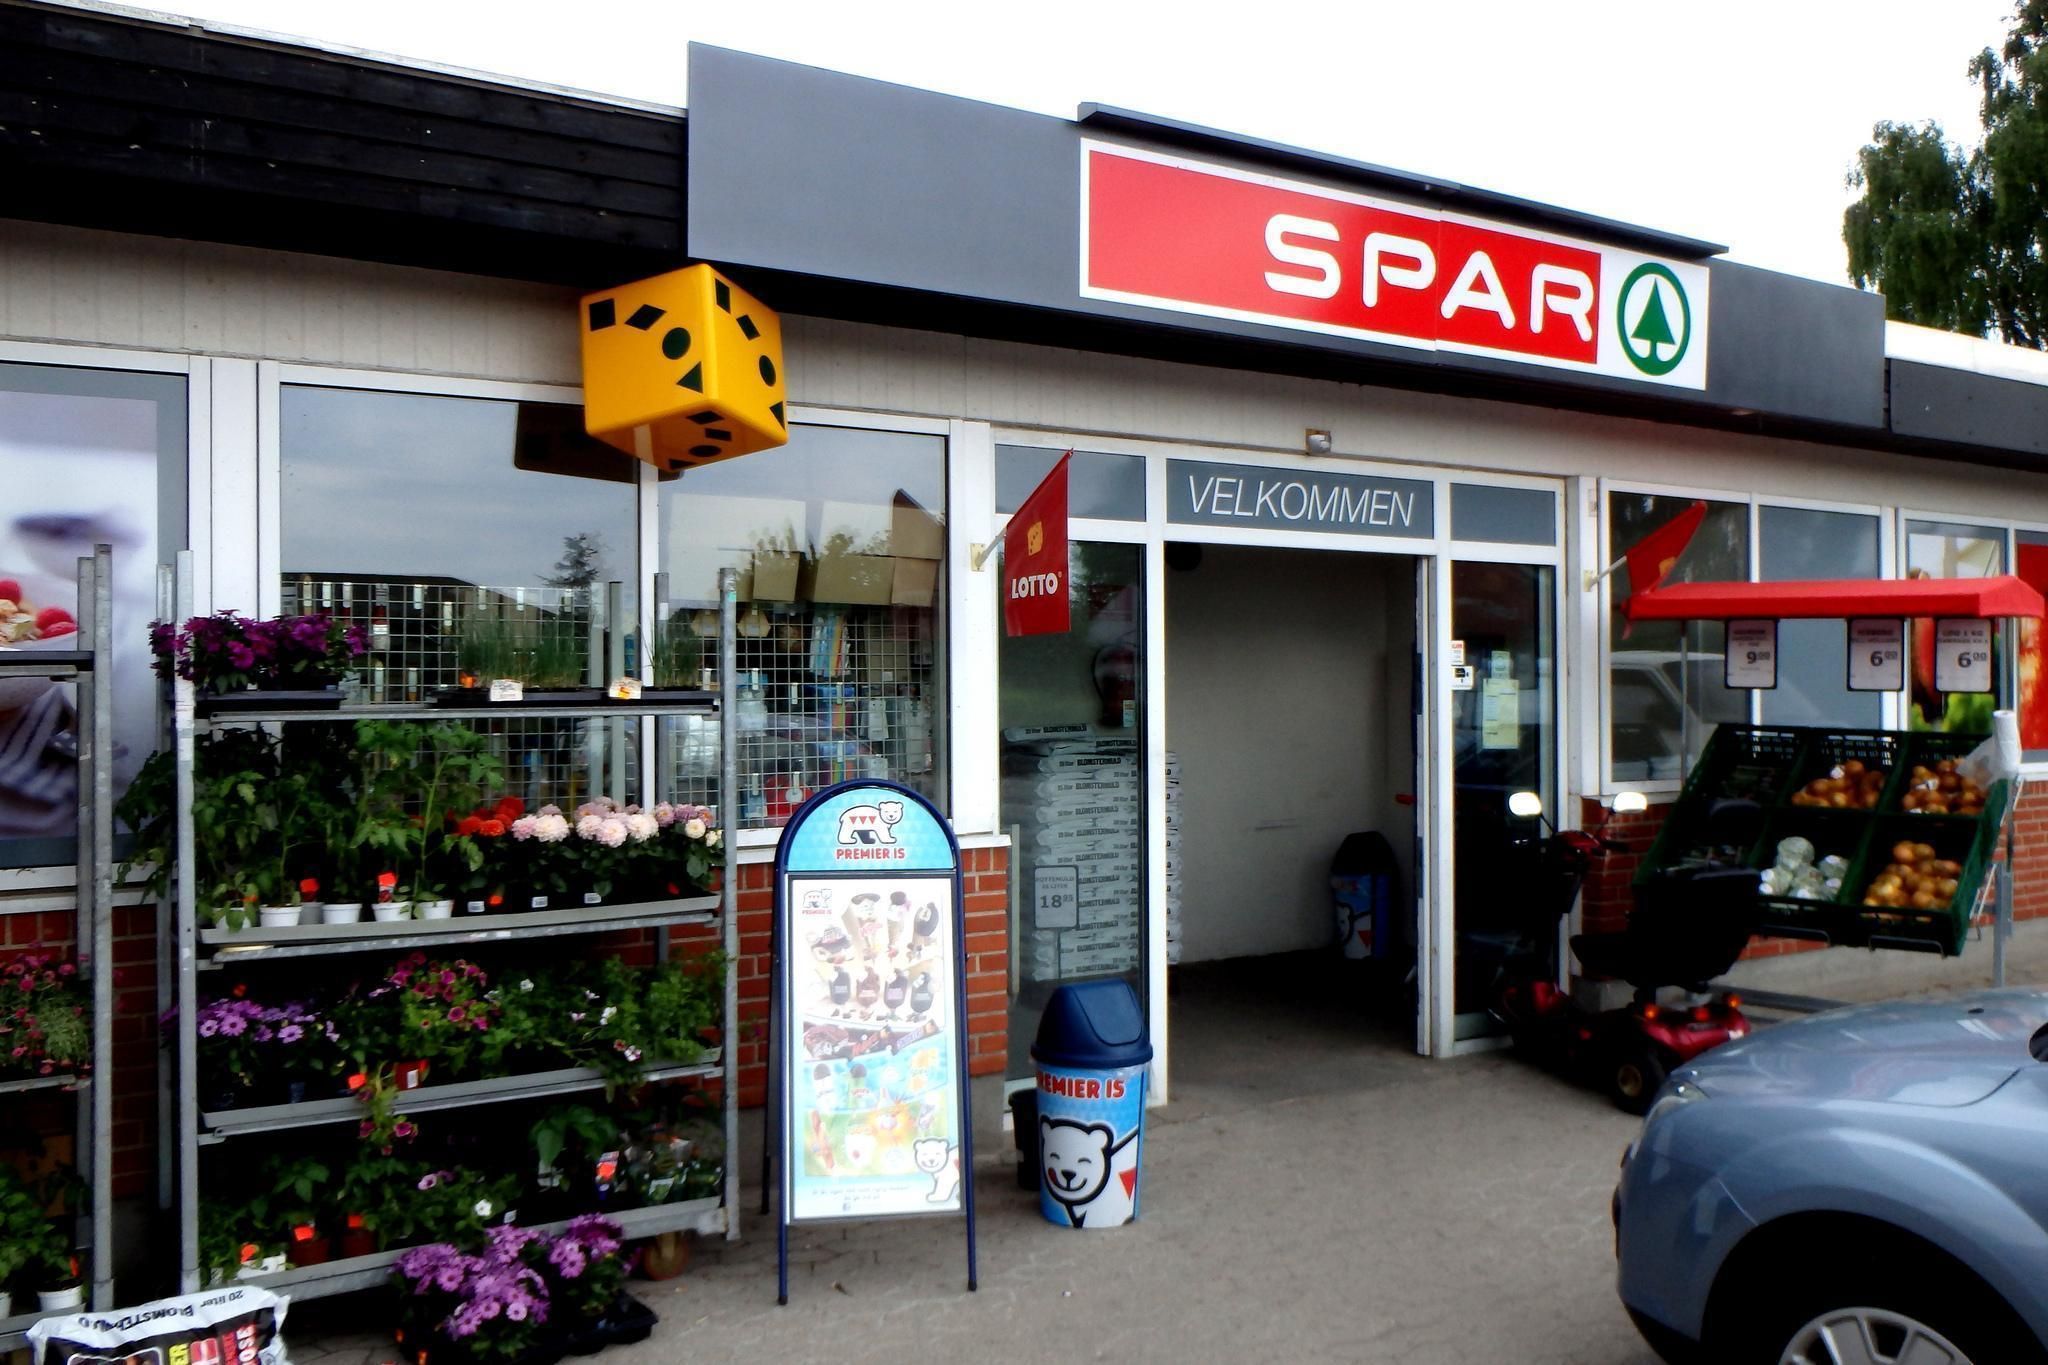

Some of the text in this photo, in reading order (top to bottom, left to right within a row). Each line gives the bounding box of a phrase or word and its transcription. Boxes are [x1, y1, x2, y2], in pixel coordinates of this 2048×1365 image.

[1264, 212, 1594, 342] SPAR
[1189, 475, 1414, 527] VELKOMMEN
[1011, 572, 1058, 599] LOTTO
[836, 848, 905, 860] PREMIER IS
[1036, 1070, 1125, 1099] REMIER IS
[78, 1290, 243, 1332] 20 liter BLOMSTEMUD
